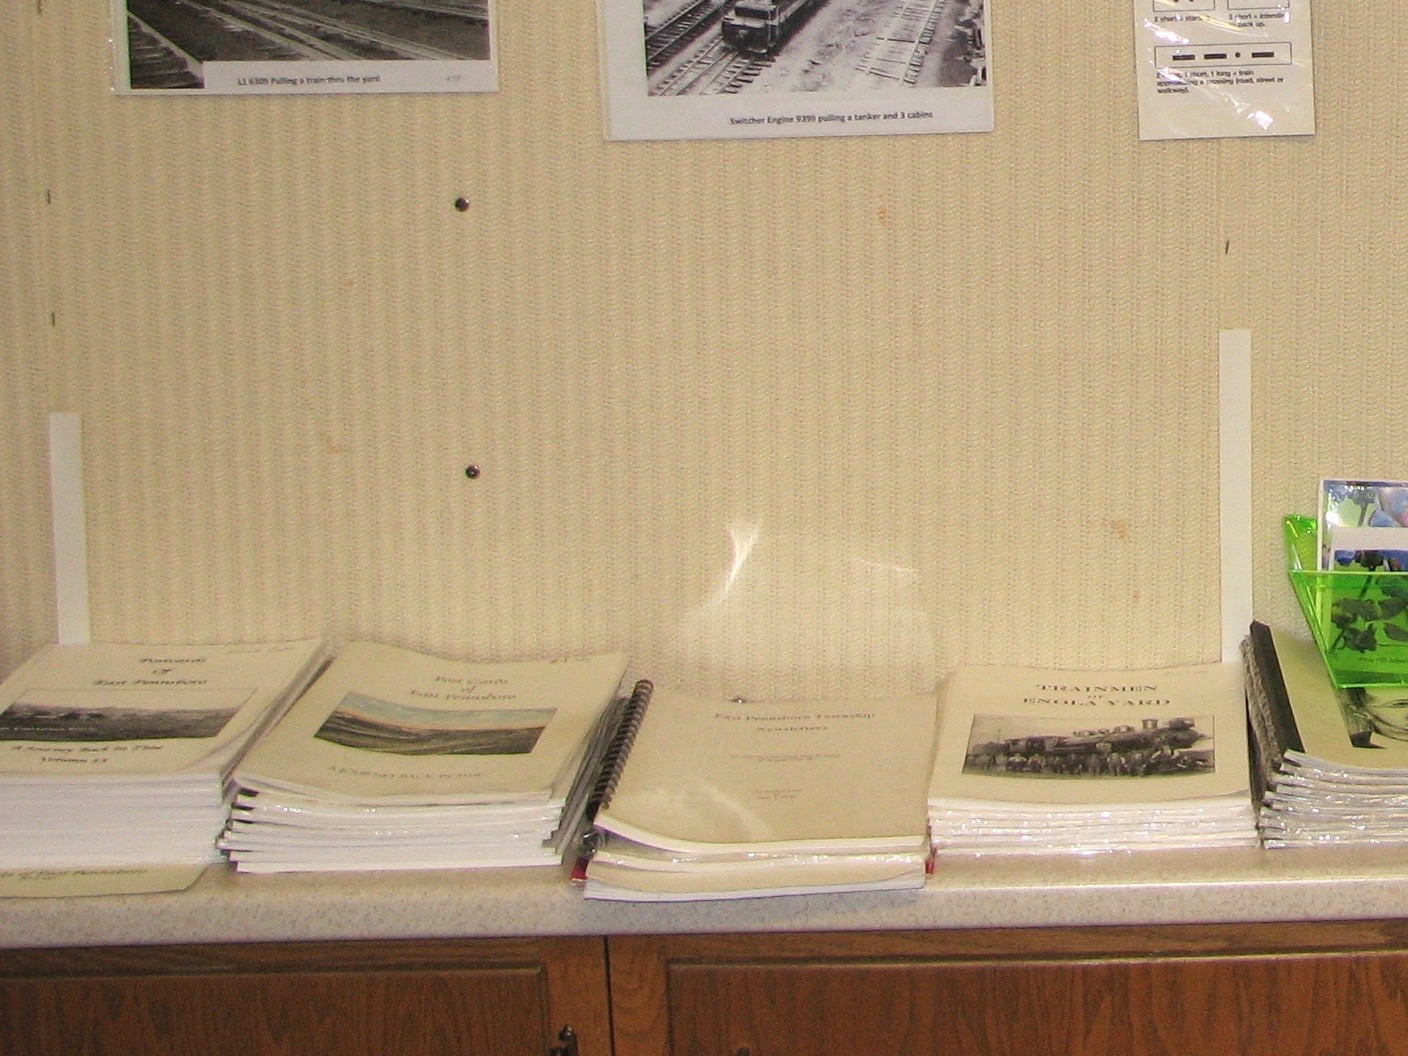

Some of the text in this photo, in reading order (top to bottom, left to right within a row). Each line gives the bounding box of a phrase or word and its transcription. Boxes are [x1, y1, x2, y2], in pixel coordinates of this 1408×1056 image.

[1216, 70, 1231, 78] long
[270, 76, 298, 86] Pulling
[346, 75, 360, 83] the
[362, 74, 380, 85] yard
[730, 116, 766, 125] Switcher
[767, 116, 794, 125] Engine
[818, 113, 846, 124] pulling
[854, 112, 881, 121] tanker
[882, 112, 898, 120] and
[907, 110, 933, 119] cabins
[1036, 684, 1158, 692] TRAINMEN
[1023, 698, 1097, 706] ENOLA
